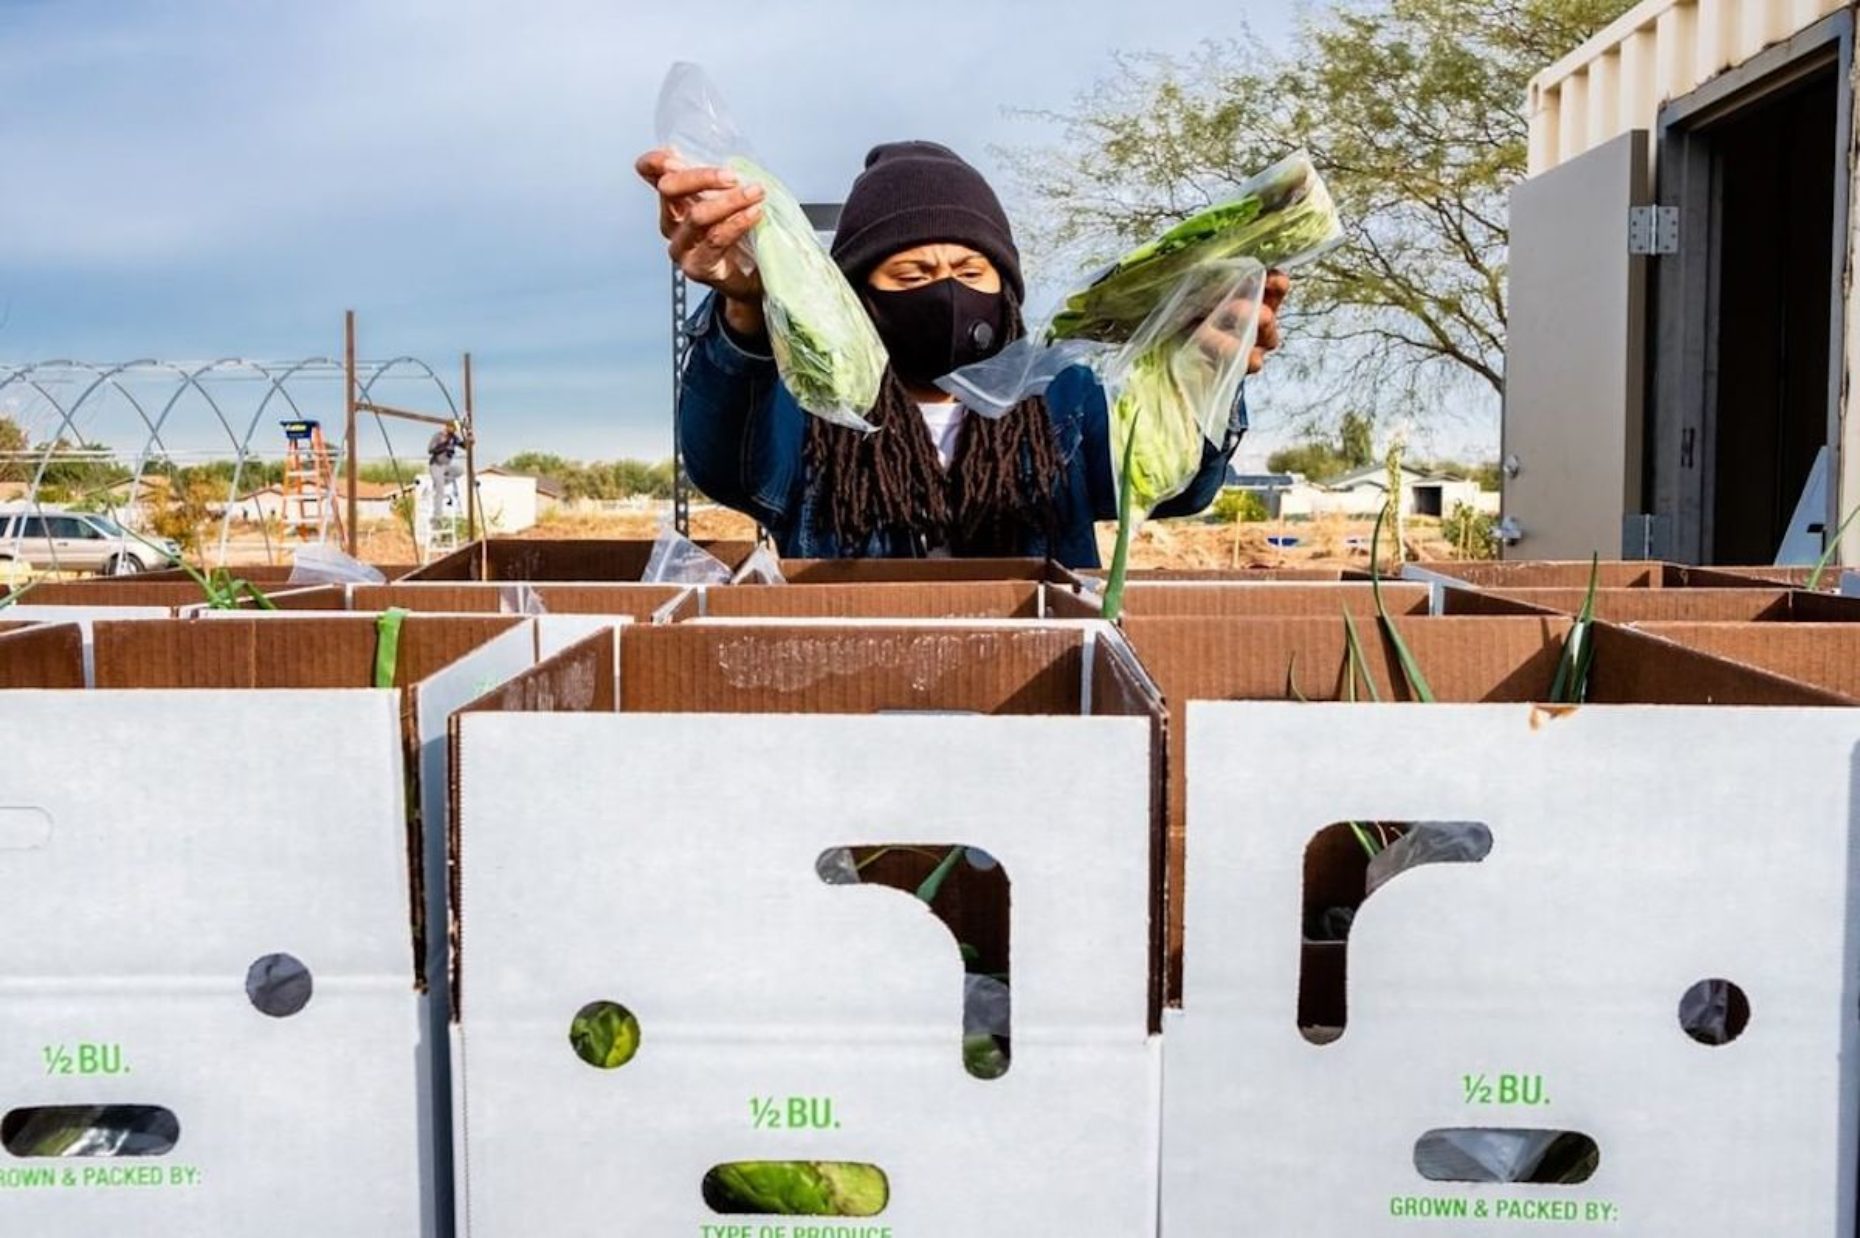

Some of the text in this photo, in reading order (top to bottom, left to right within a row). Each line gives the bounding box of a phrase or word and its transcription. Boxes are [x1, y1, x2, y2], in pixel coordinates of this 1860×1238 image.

[78, 1044, 131, 1074] BU.
[1498, 1074, 1550, 1105] BU.
[787, 1096, 840, 1129] BU.
[61, 1168, 77, 1186] &
[83, 1166, 163, 1186] PACKED
[170, 1166, 201, 1186] BY:
[1390, 1197, 1619, 1222] GROWN & PACKED BY:
[701, 1225, 752, 1238] TYPE
[759, 1226, 787, 1238] OF
